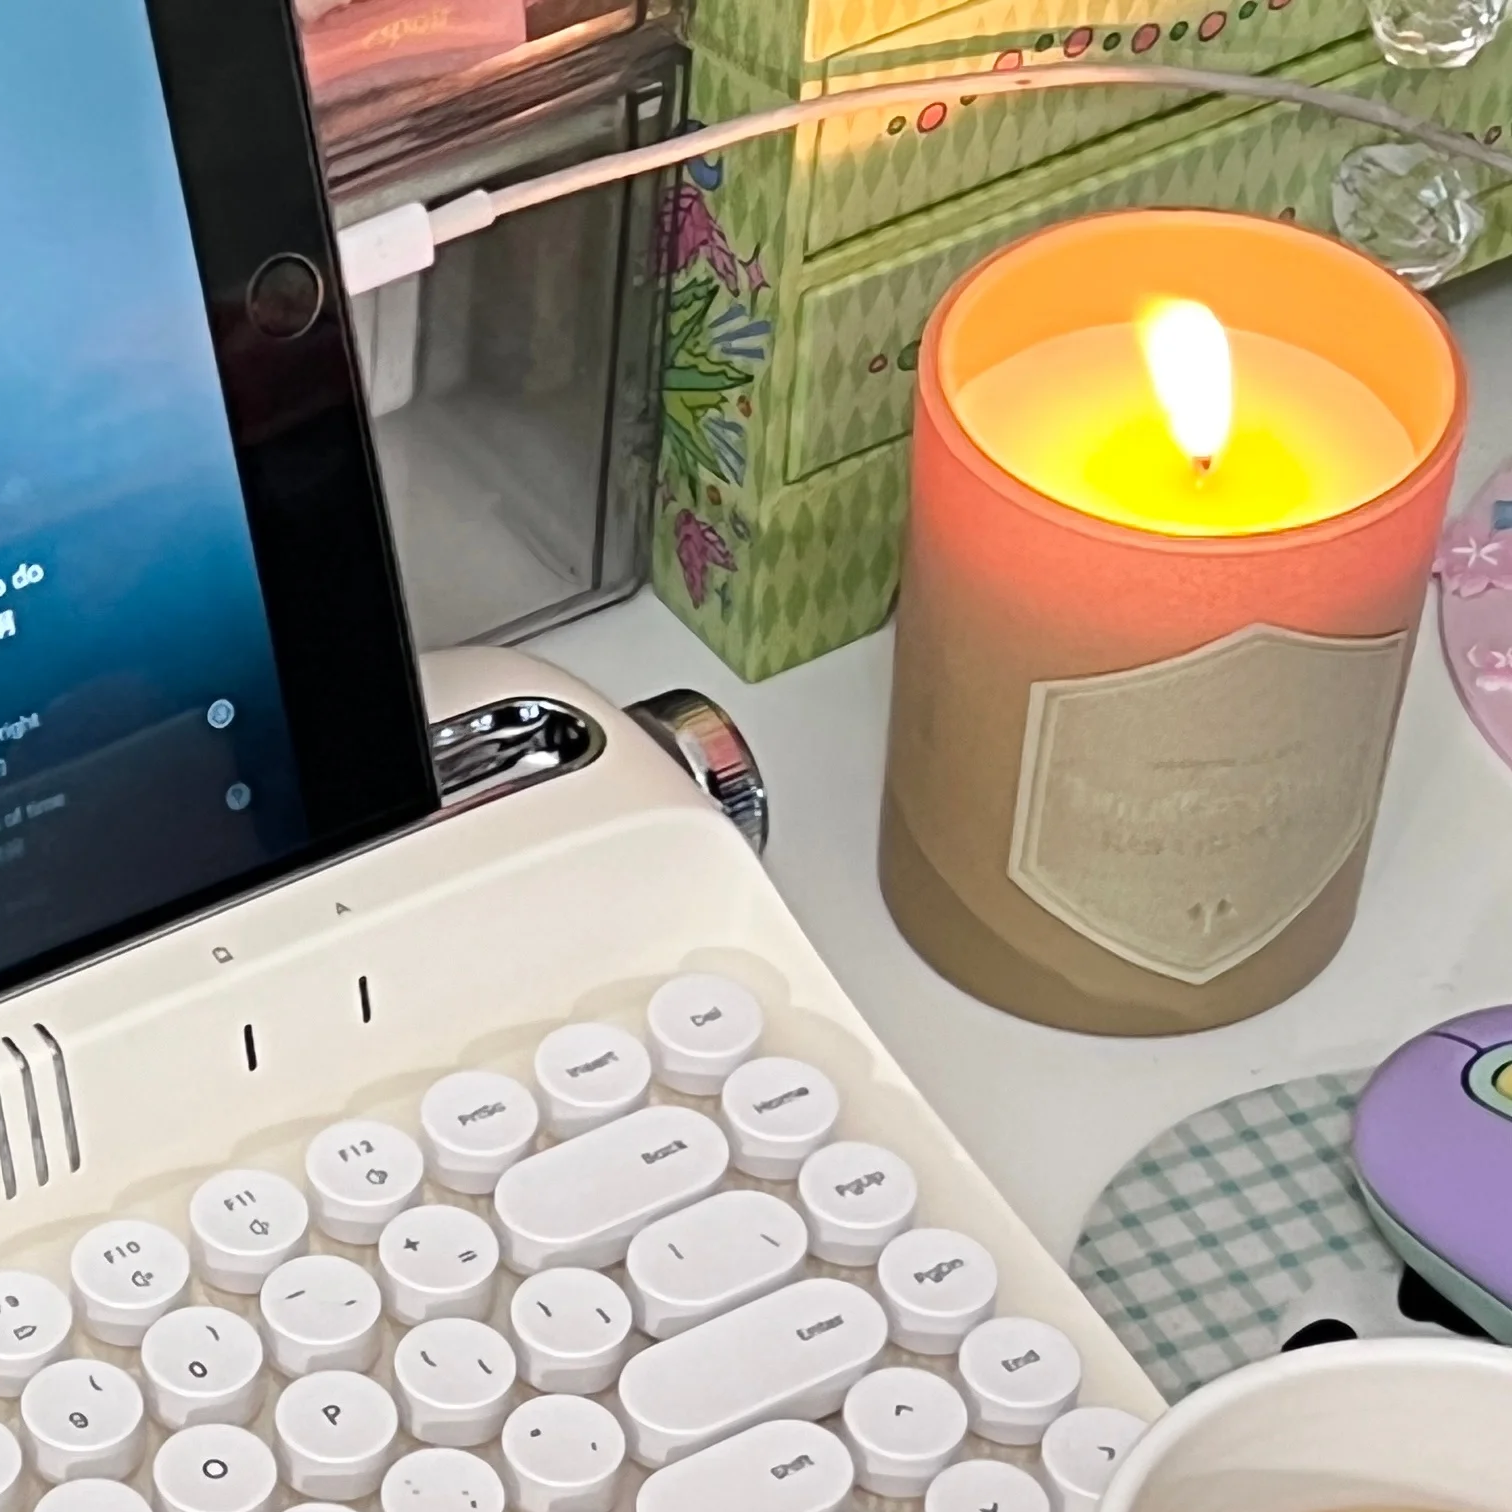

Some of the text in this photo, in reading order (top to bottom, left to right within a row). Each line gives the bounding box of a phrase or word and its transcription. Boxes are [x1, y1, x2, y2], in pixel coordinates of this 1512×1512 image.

[12, 562, 45, 590] do
[103, 1240, 141, 1264] F10
[322, 1404, 342, 1426] P
